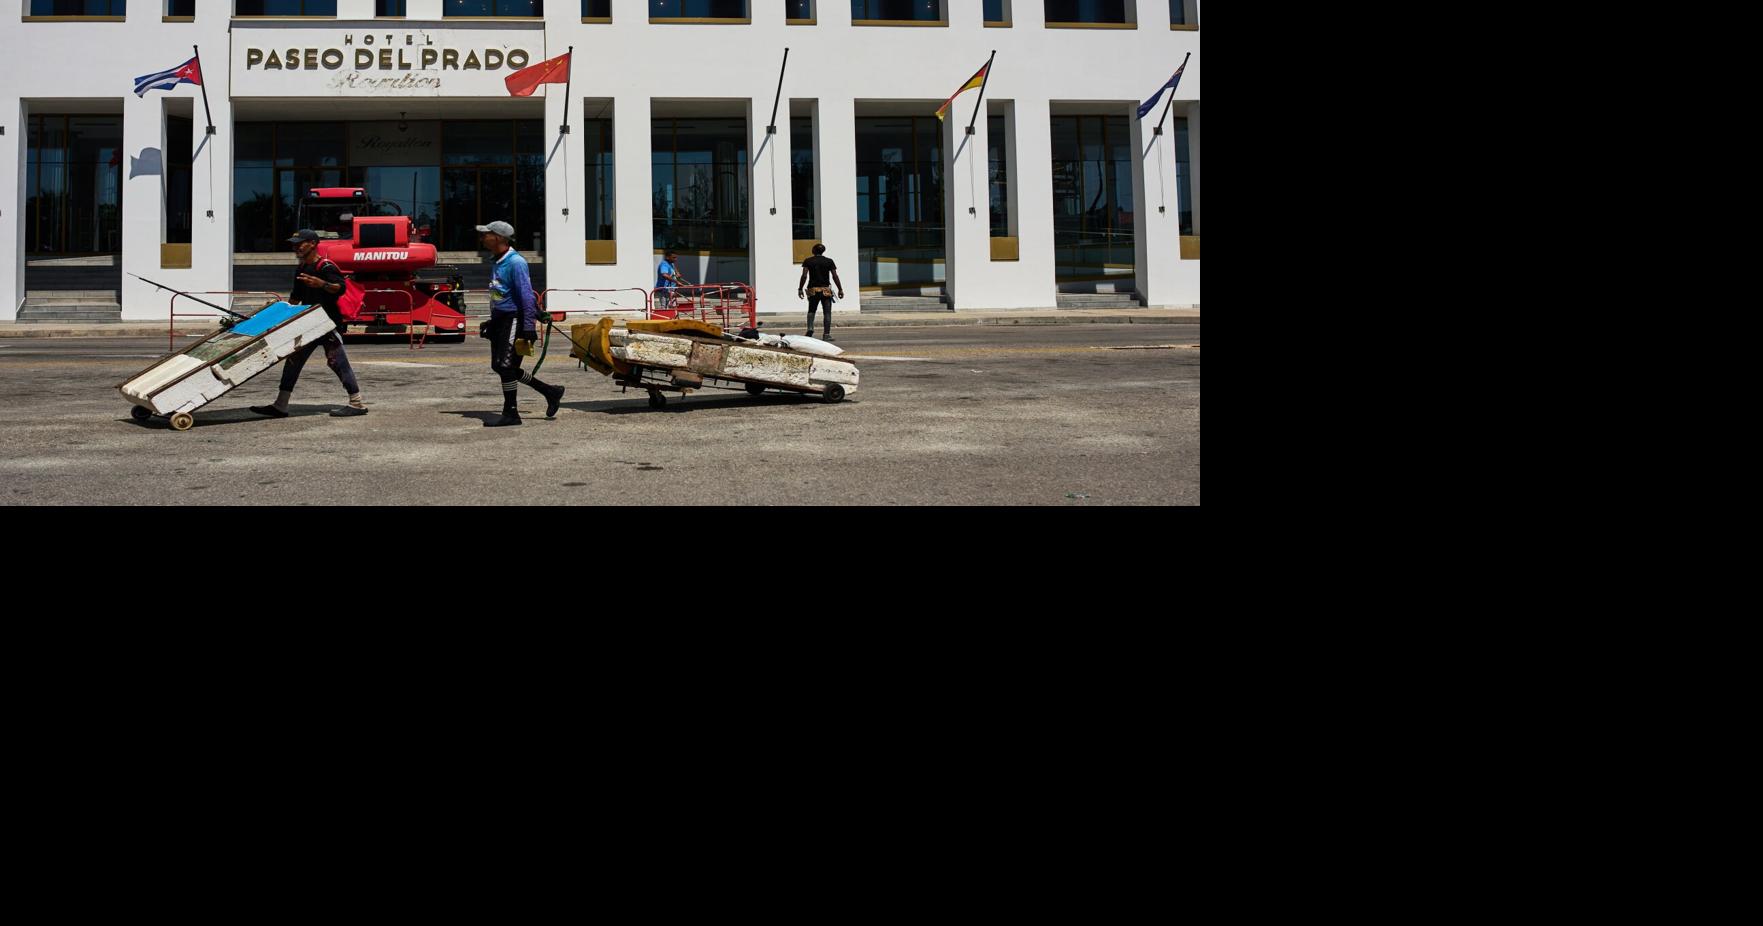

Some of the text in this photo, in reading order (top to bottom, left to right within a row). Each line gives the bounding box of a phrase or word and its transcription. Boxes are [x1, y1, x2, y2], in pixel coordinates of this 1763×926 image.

[344, 34, 433, 46] HOTEL
[246, 48, 530, 70] PASEO DEL PRADO
[353, 251, 409, 261] MANITOU
